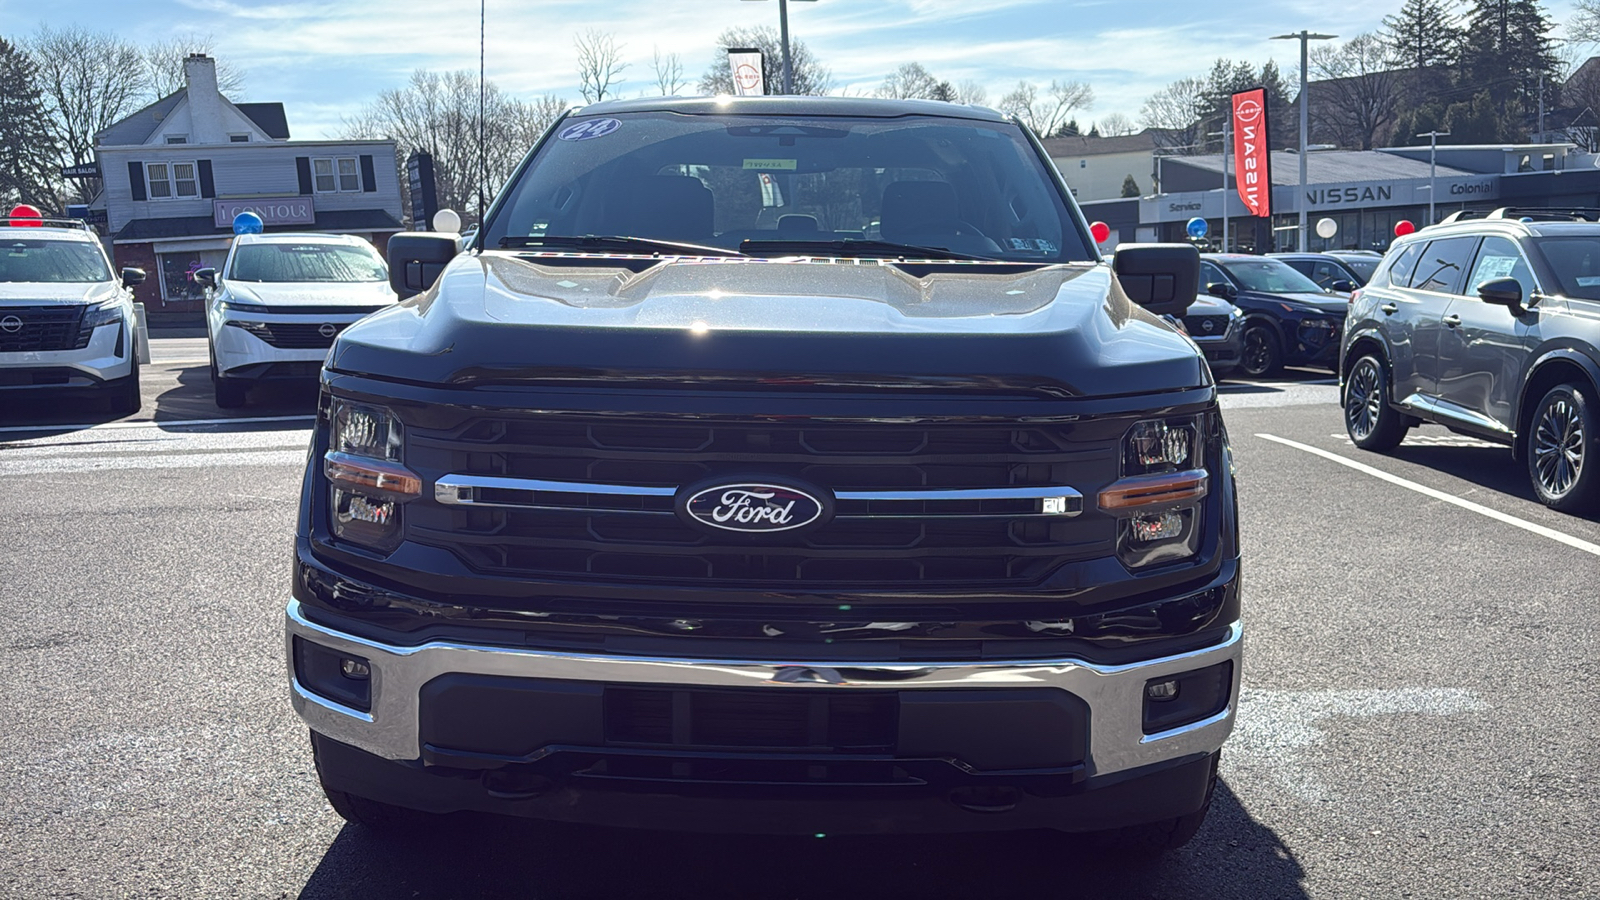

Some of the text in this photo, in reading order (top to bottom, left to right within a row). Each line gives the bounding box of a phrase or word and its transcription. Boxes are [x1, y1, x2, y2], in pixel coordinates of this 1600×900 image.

[564, 119, 614, 139] 24
[63, 167, 77, 175] HAIR
[1306, 185, 1392, 205] NISSAN
[1451, 181, 1493, 195] Colonial
[1169, 201, 1202, 212] Service
[712, 490, 796, 524] Ford
